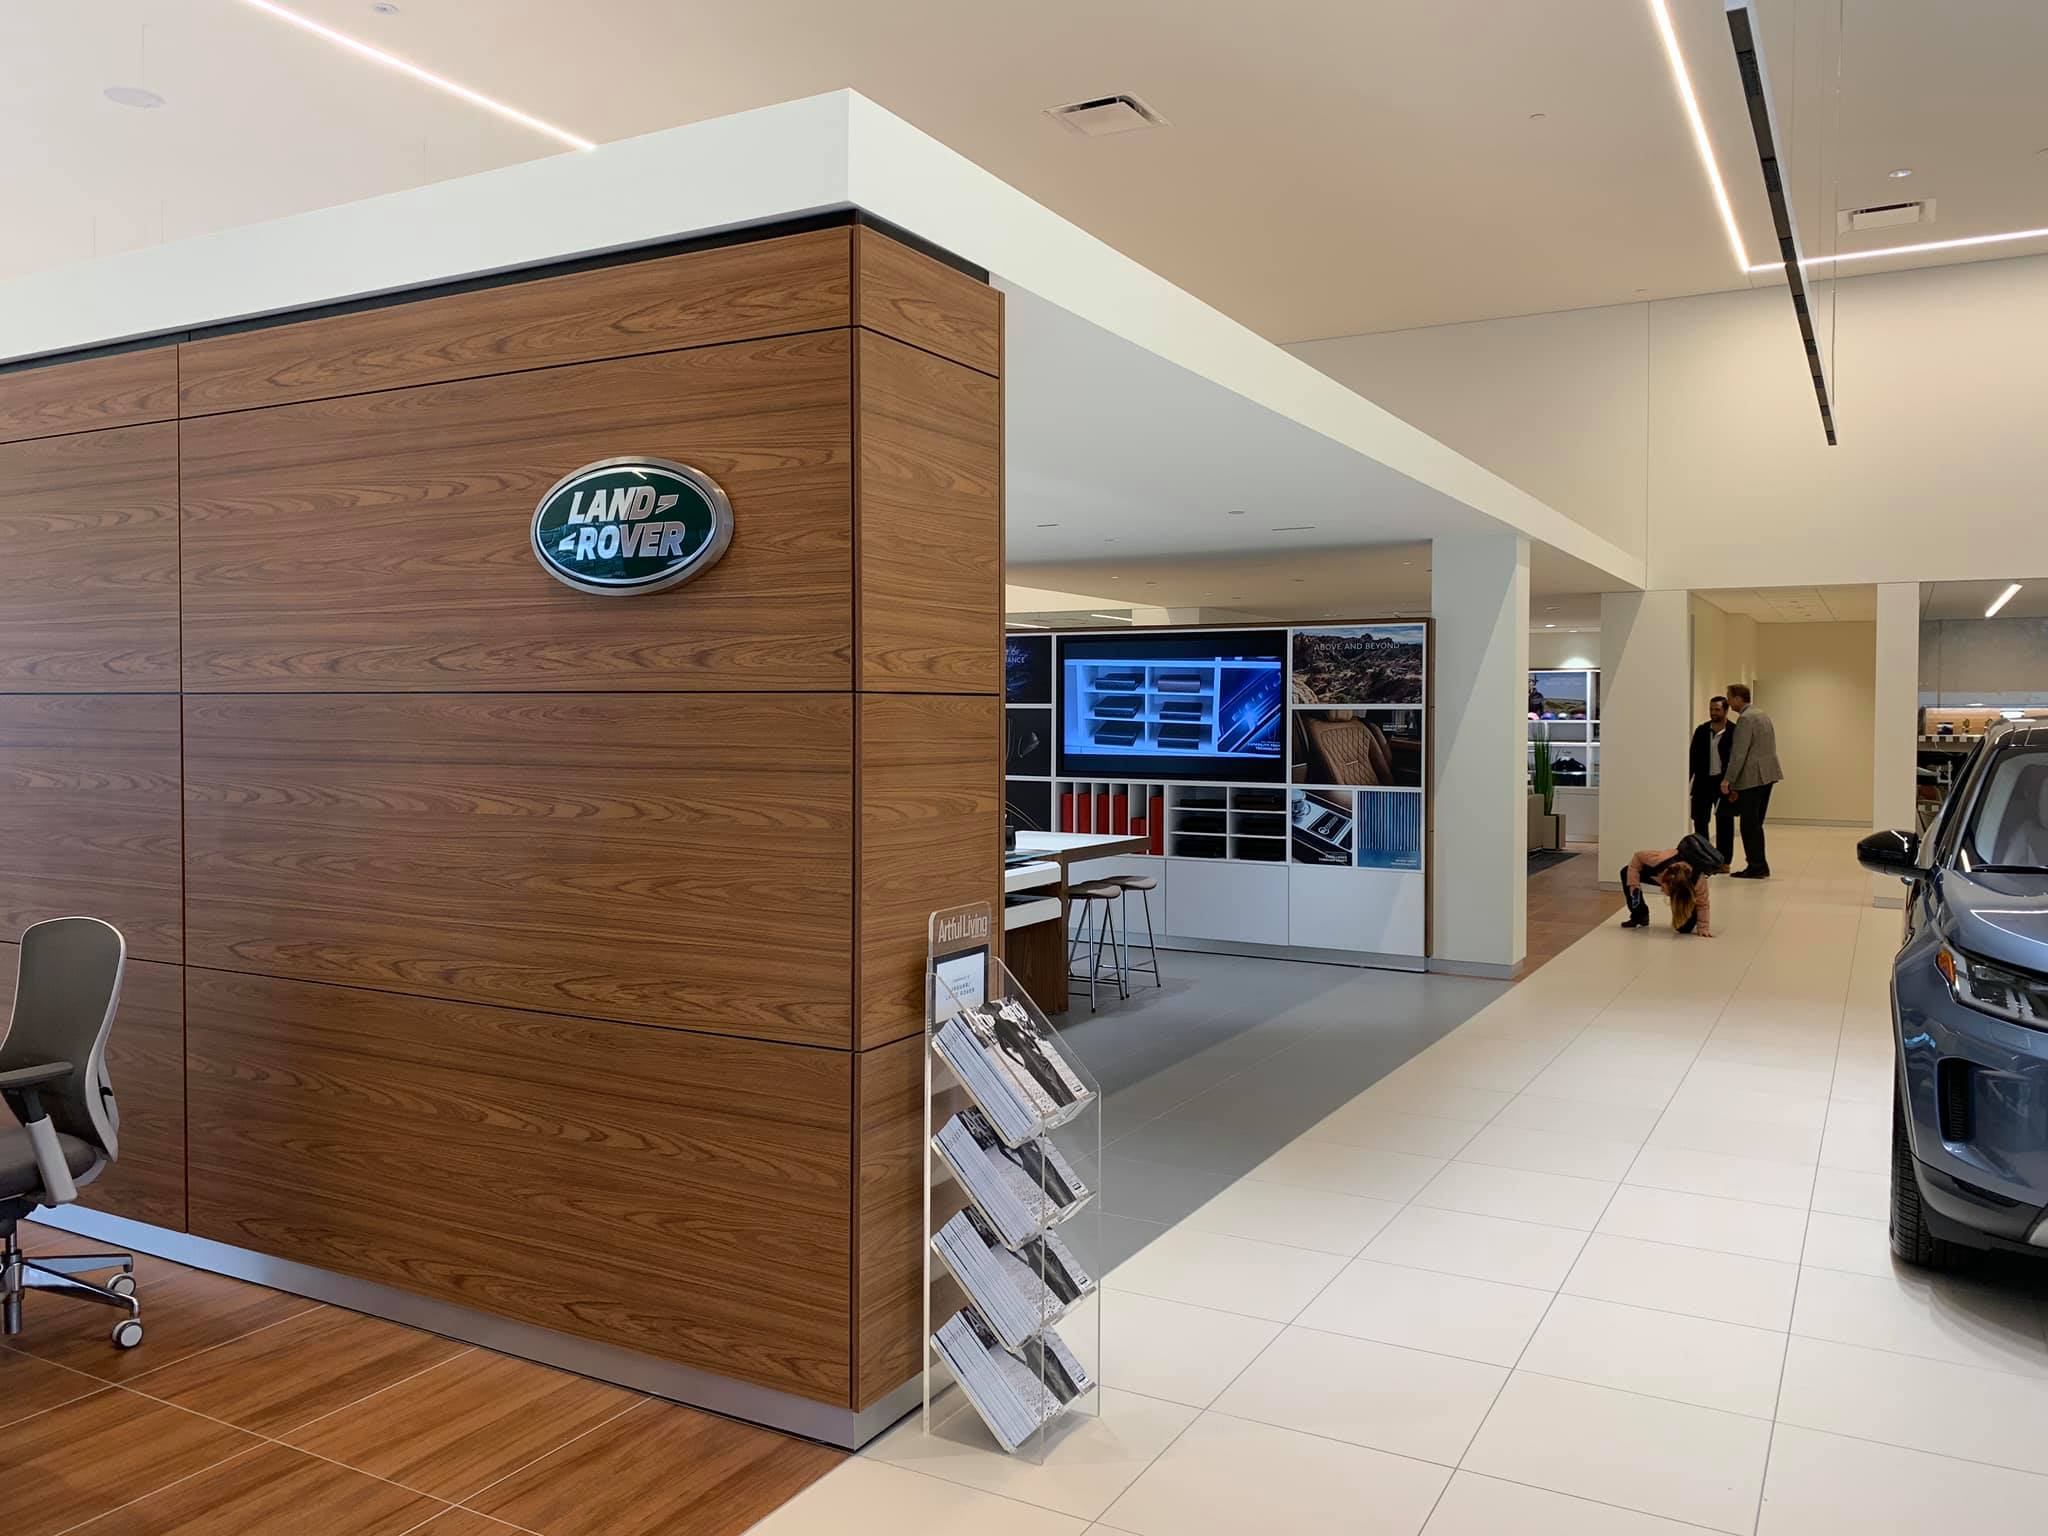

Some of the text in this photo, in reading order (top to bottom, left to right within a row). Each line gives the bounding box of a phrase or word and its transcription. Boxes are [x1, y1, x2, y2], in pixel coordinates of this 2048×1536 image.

[568, 486, 656, 524] LAND
[576, 521, 686, 561] ROVER
[1313, 642, 1400, 651] ABOVE AND BEYOND
[938, 913, 988, 943] Artful Living
